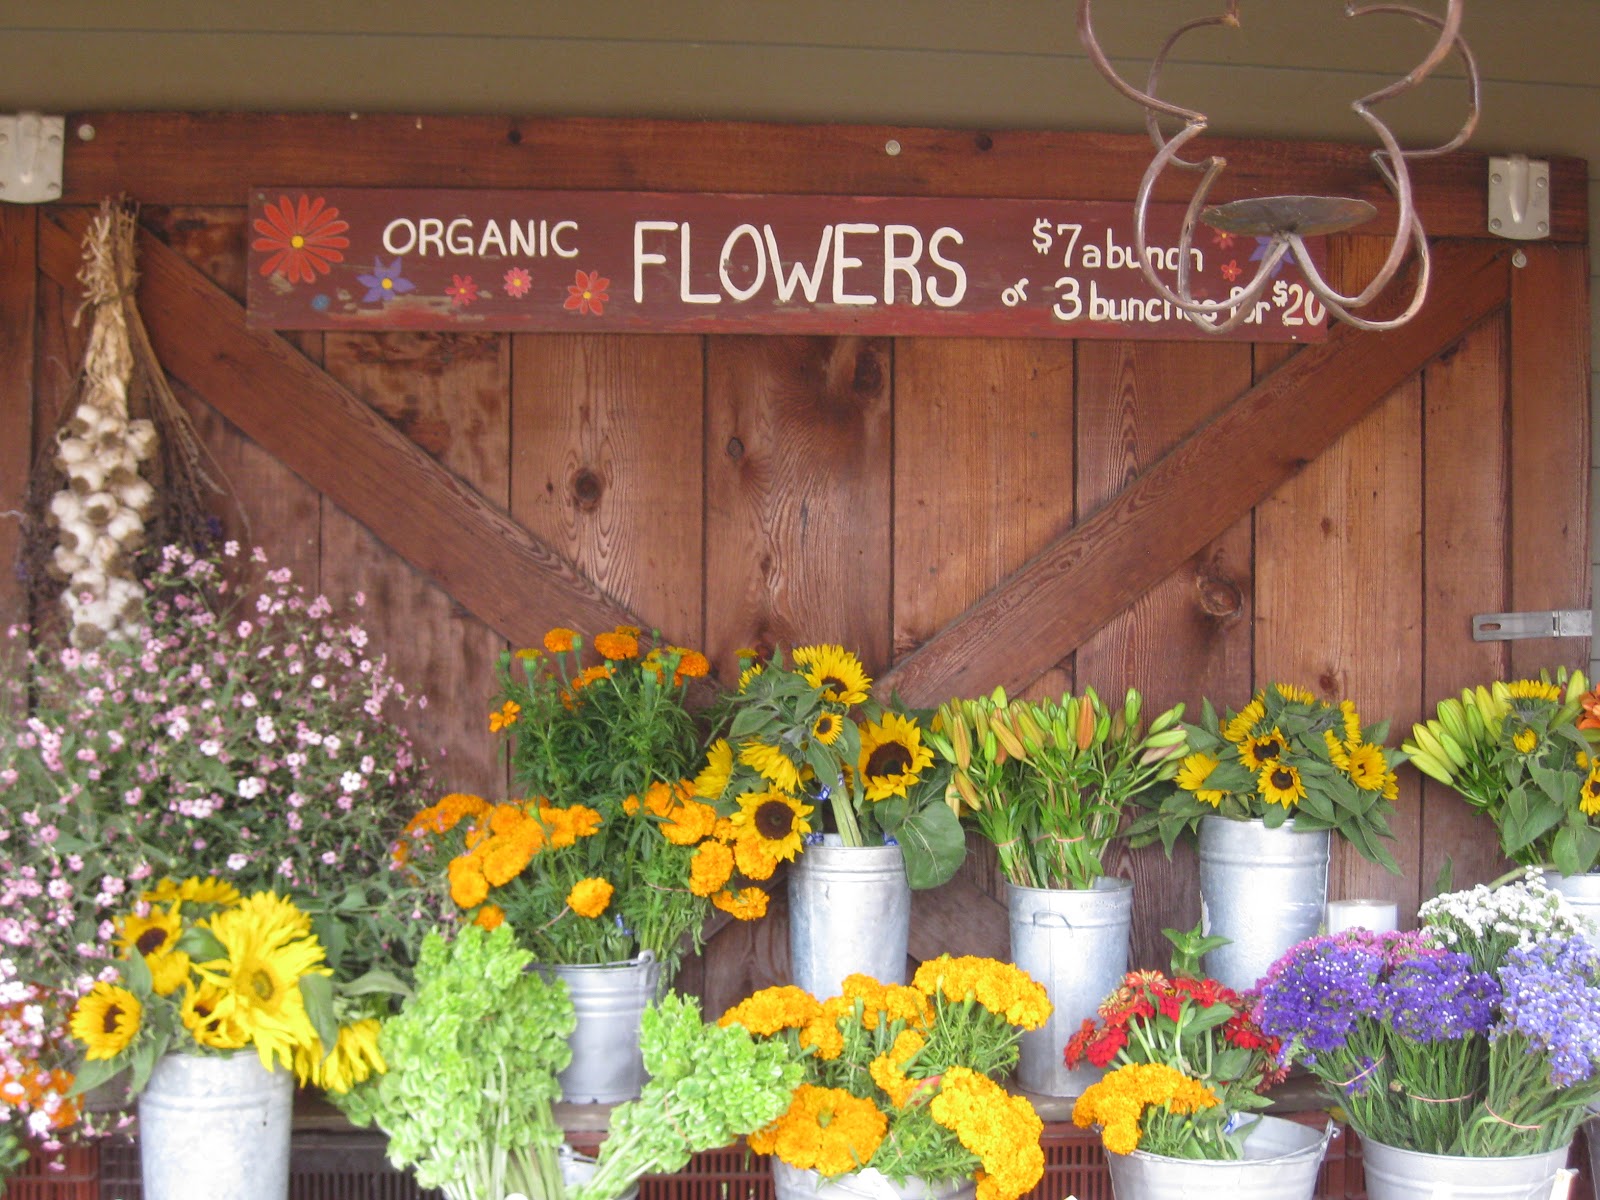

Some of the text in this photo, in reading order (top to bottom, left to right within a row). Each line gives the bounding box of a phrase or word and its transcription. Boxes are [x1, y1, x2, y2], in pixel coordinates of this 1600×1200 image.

[382, 218, 967, 307] ORGANIC FLOWERS
[1032, 217, 1082, 268] $7
[1082, 244, 1101, 268] a
[1001, 278, 1029, 307] or
[1053, 276, 1083, 321] 3
[1230, 286, 1270, 324] fr
[1272, 280, 1326, 326] $20
